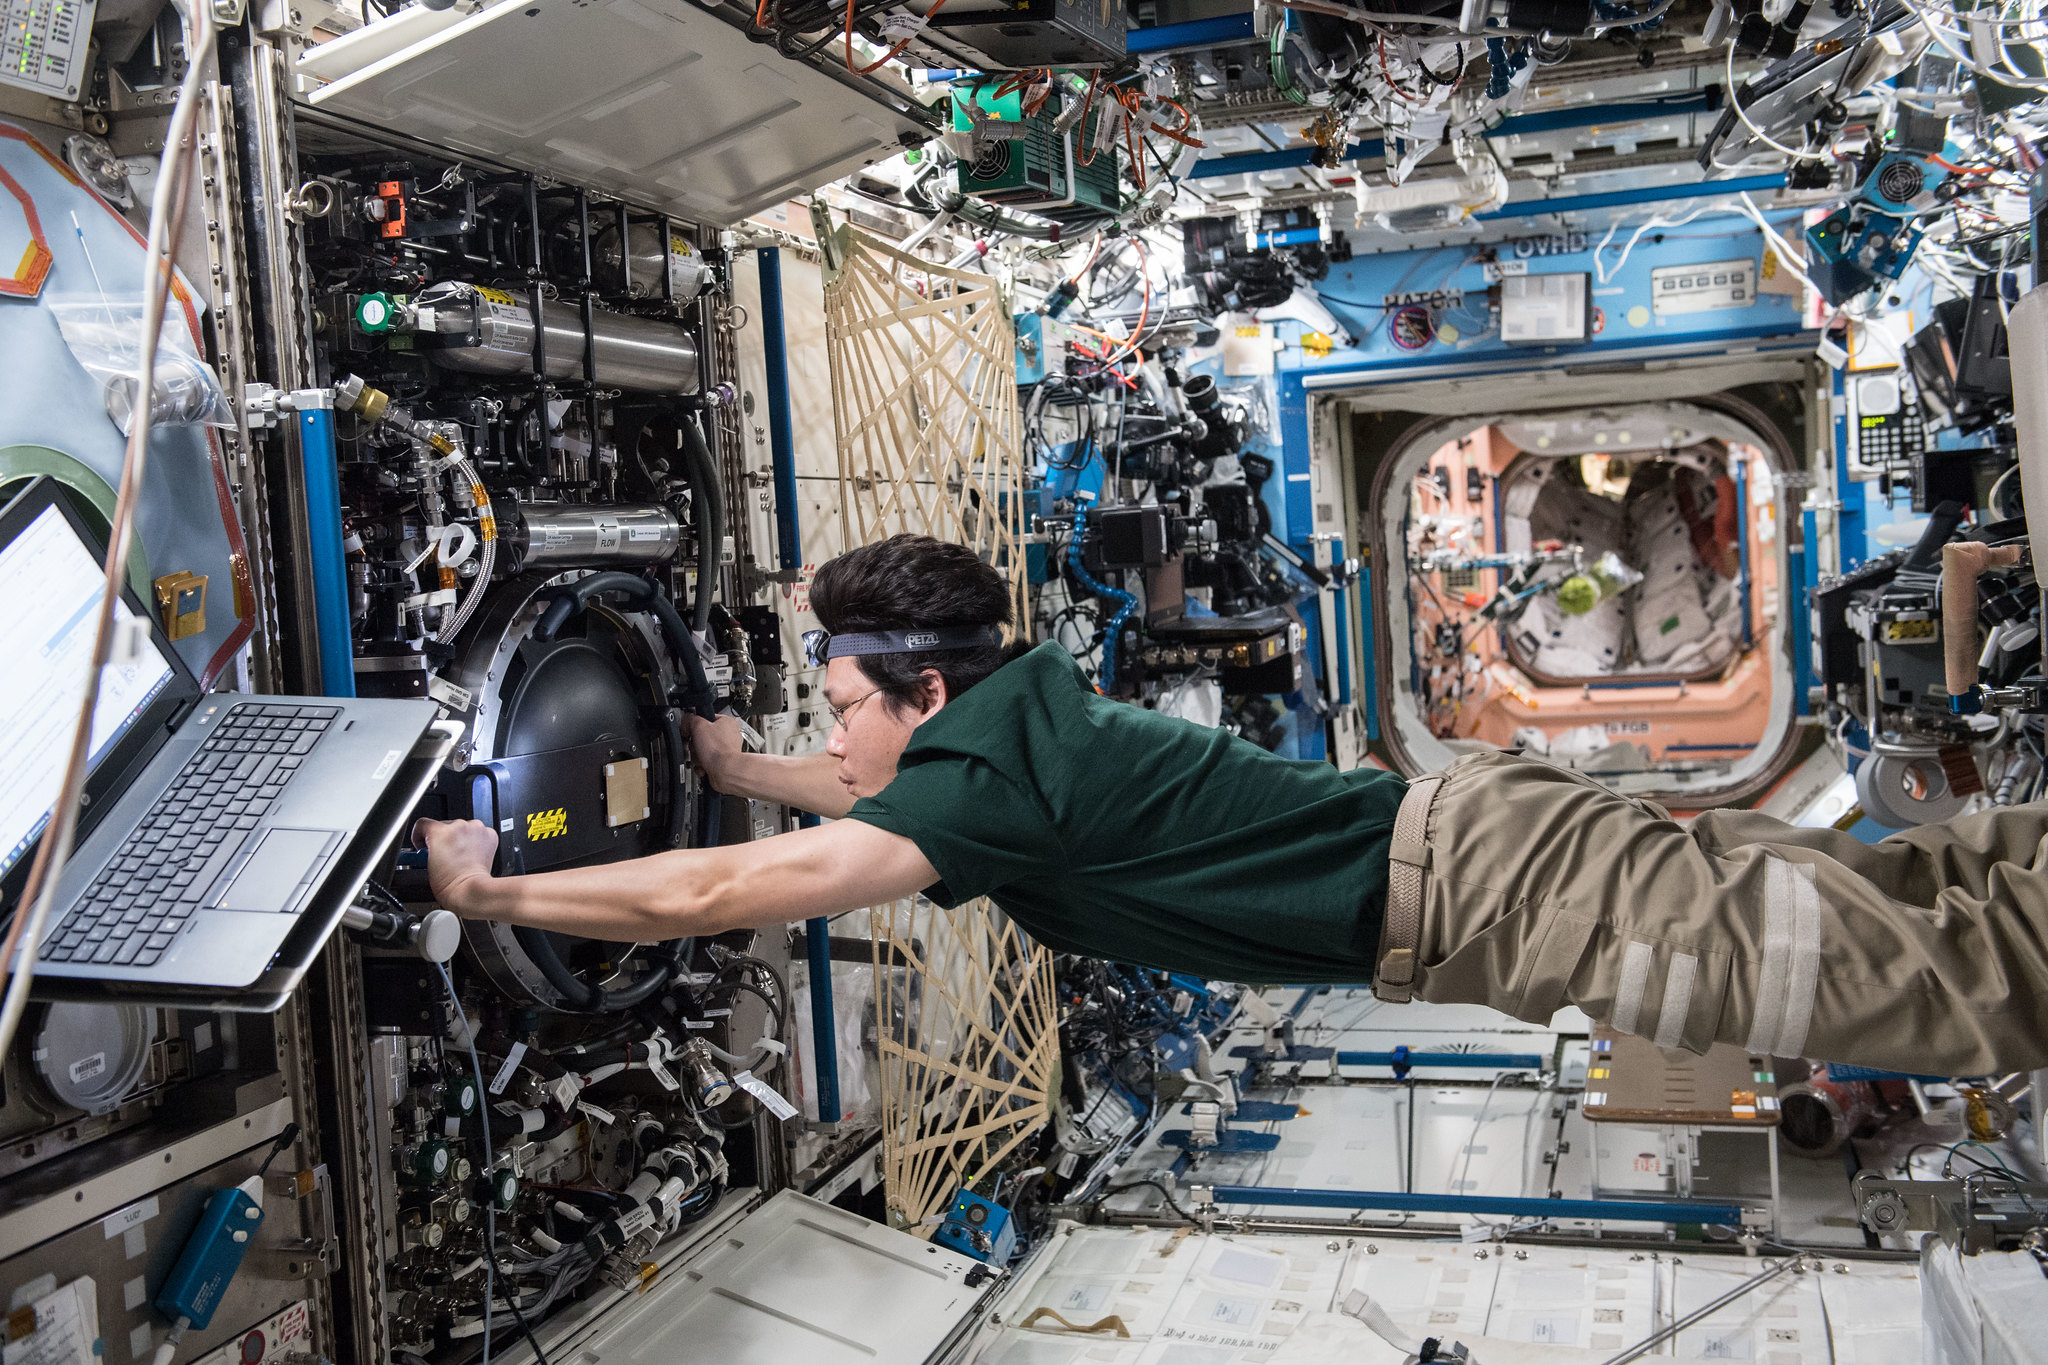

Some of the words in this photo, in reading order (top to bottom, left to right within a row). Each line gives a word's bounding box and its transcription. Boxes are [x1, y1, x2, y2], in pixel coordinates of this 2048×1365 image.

[1515, 235, 1587, 258] OVHD
[1384, 288, 1463, 314] HATCH
[600, 538, 617, 548] FLOW
[906, 632, 938, 649] PETZL
